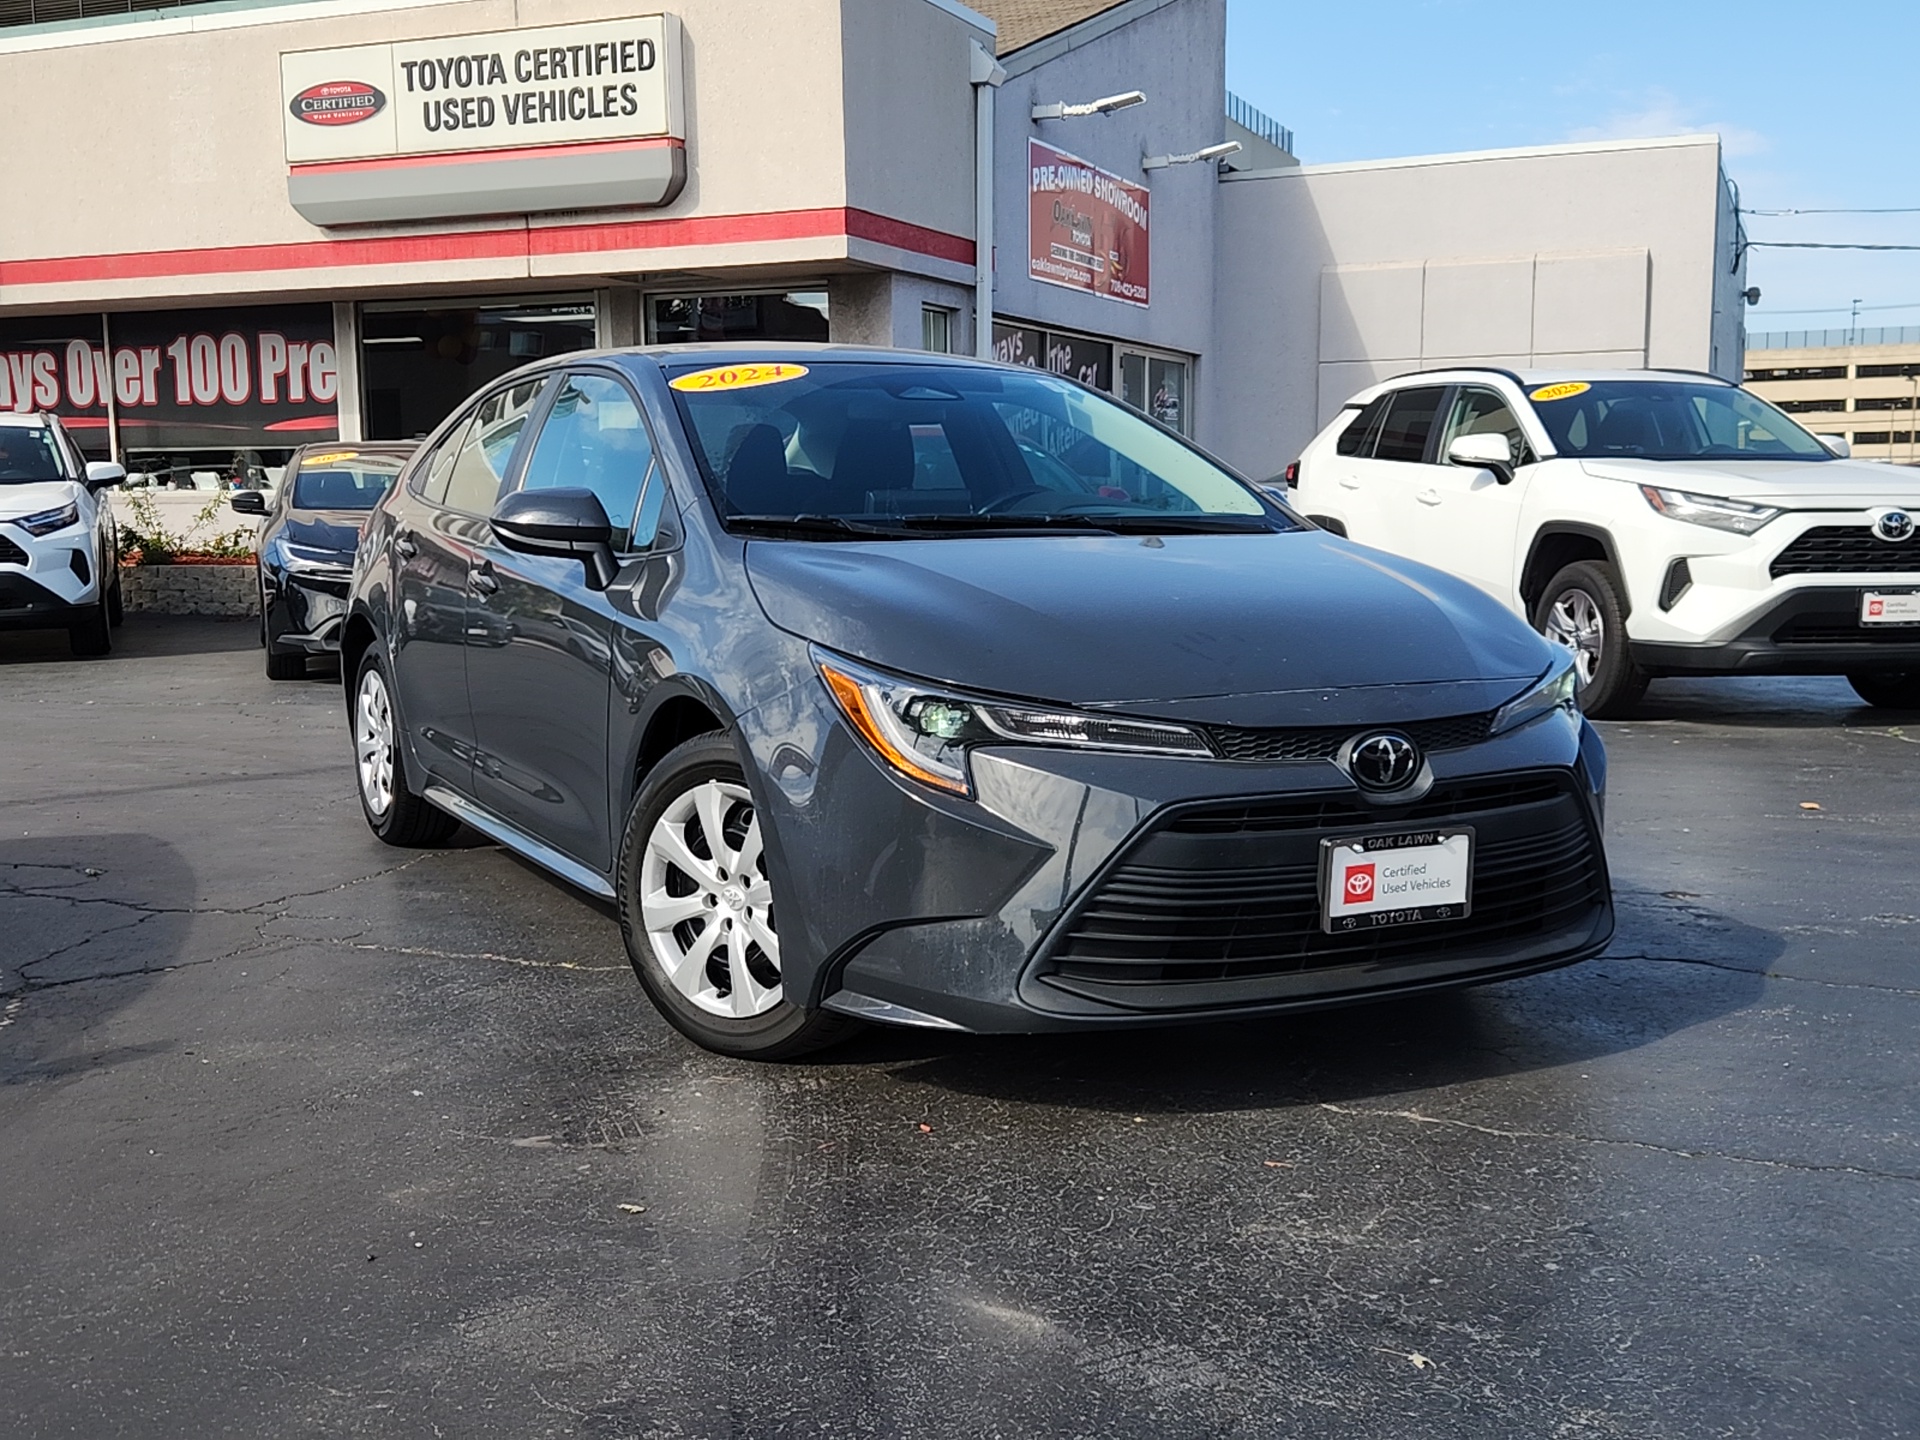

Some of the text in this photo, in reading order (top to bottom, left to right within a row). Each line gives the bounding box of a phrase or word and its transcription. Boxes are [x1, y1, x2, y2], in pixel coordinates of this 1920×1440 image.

[400, 38, 656, 92] TOYOTA CERTIFIED
[301, 95, 375, 111] CERTIFIED
[423, 82, 638, 132] USED VEHICLES
[1033, 165, 1093, 194] PRE-OWNED
[1094, 176, 1148, 231] SHOWROOM
[168, 334, 248, 404] 100
[258, 332, 338, 402] Pre
[1050, 343, 1072, 374] The
[697, 365, 784, 389] 2024
[1078, 362, 1098, 387] car
[1544, 384, 1580, 399] 2025
[1368, 833, 1434, 849] OAK LAWN
[1382, 863, 1427, 878] Certified
[1381, 877, 1451, 894] Used Vehicles
[1370, 909, 1422, 925] TOYOTA
